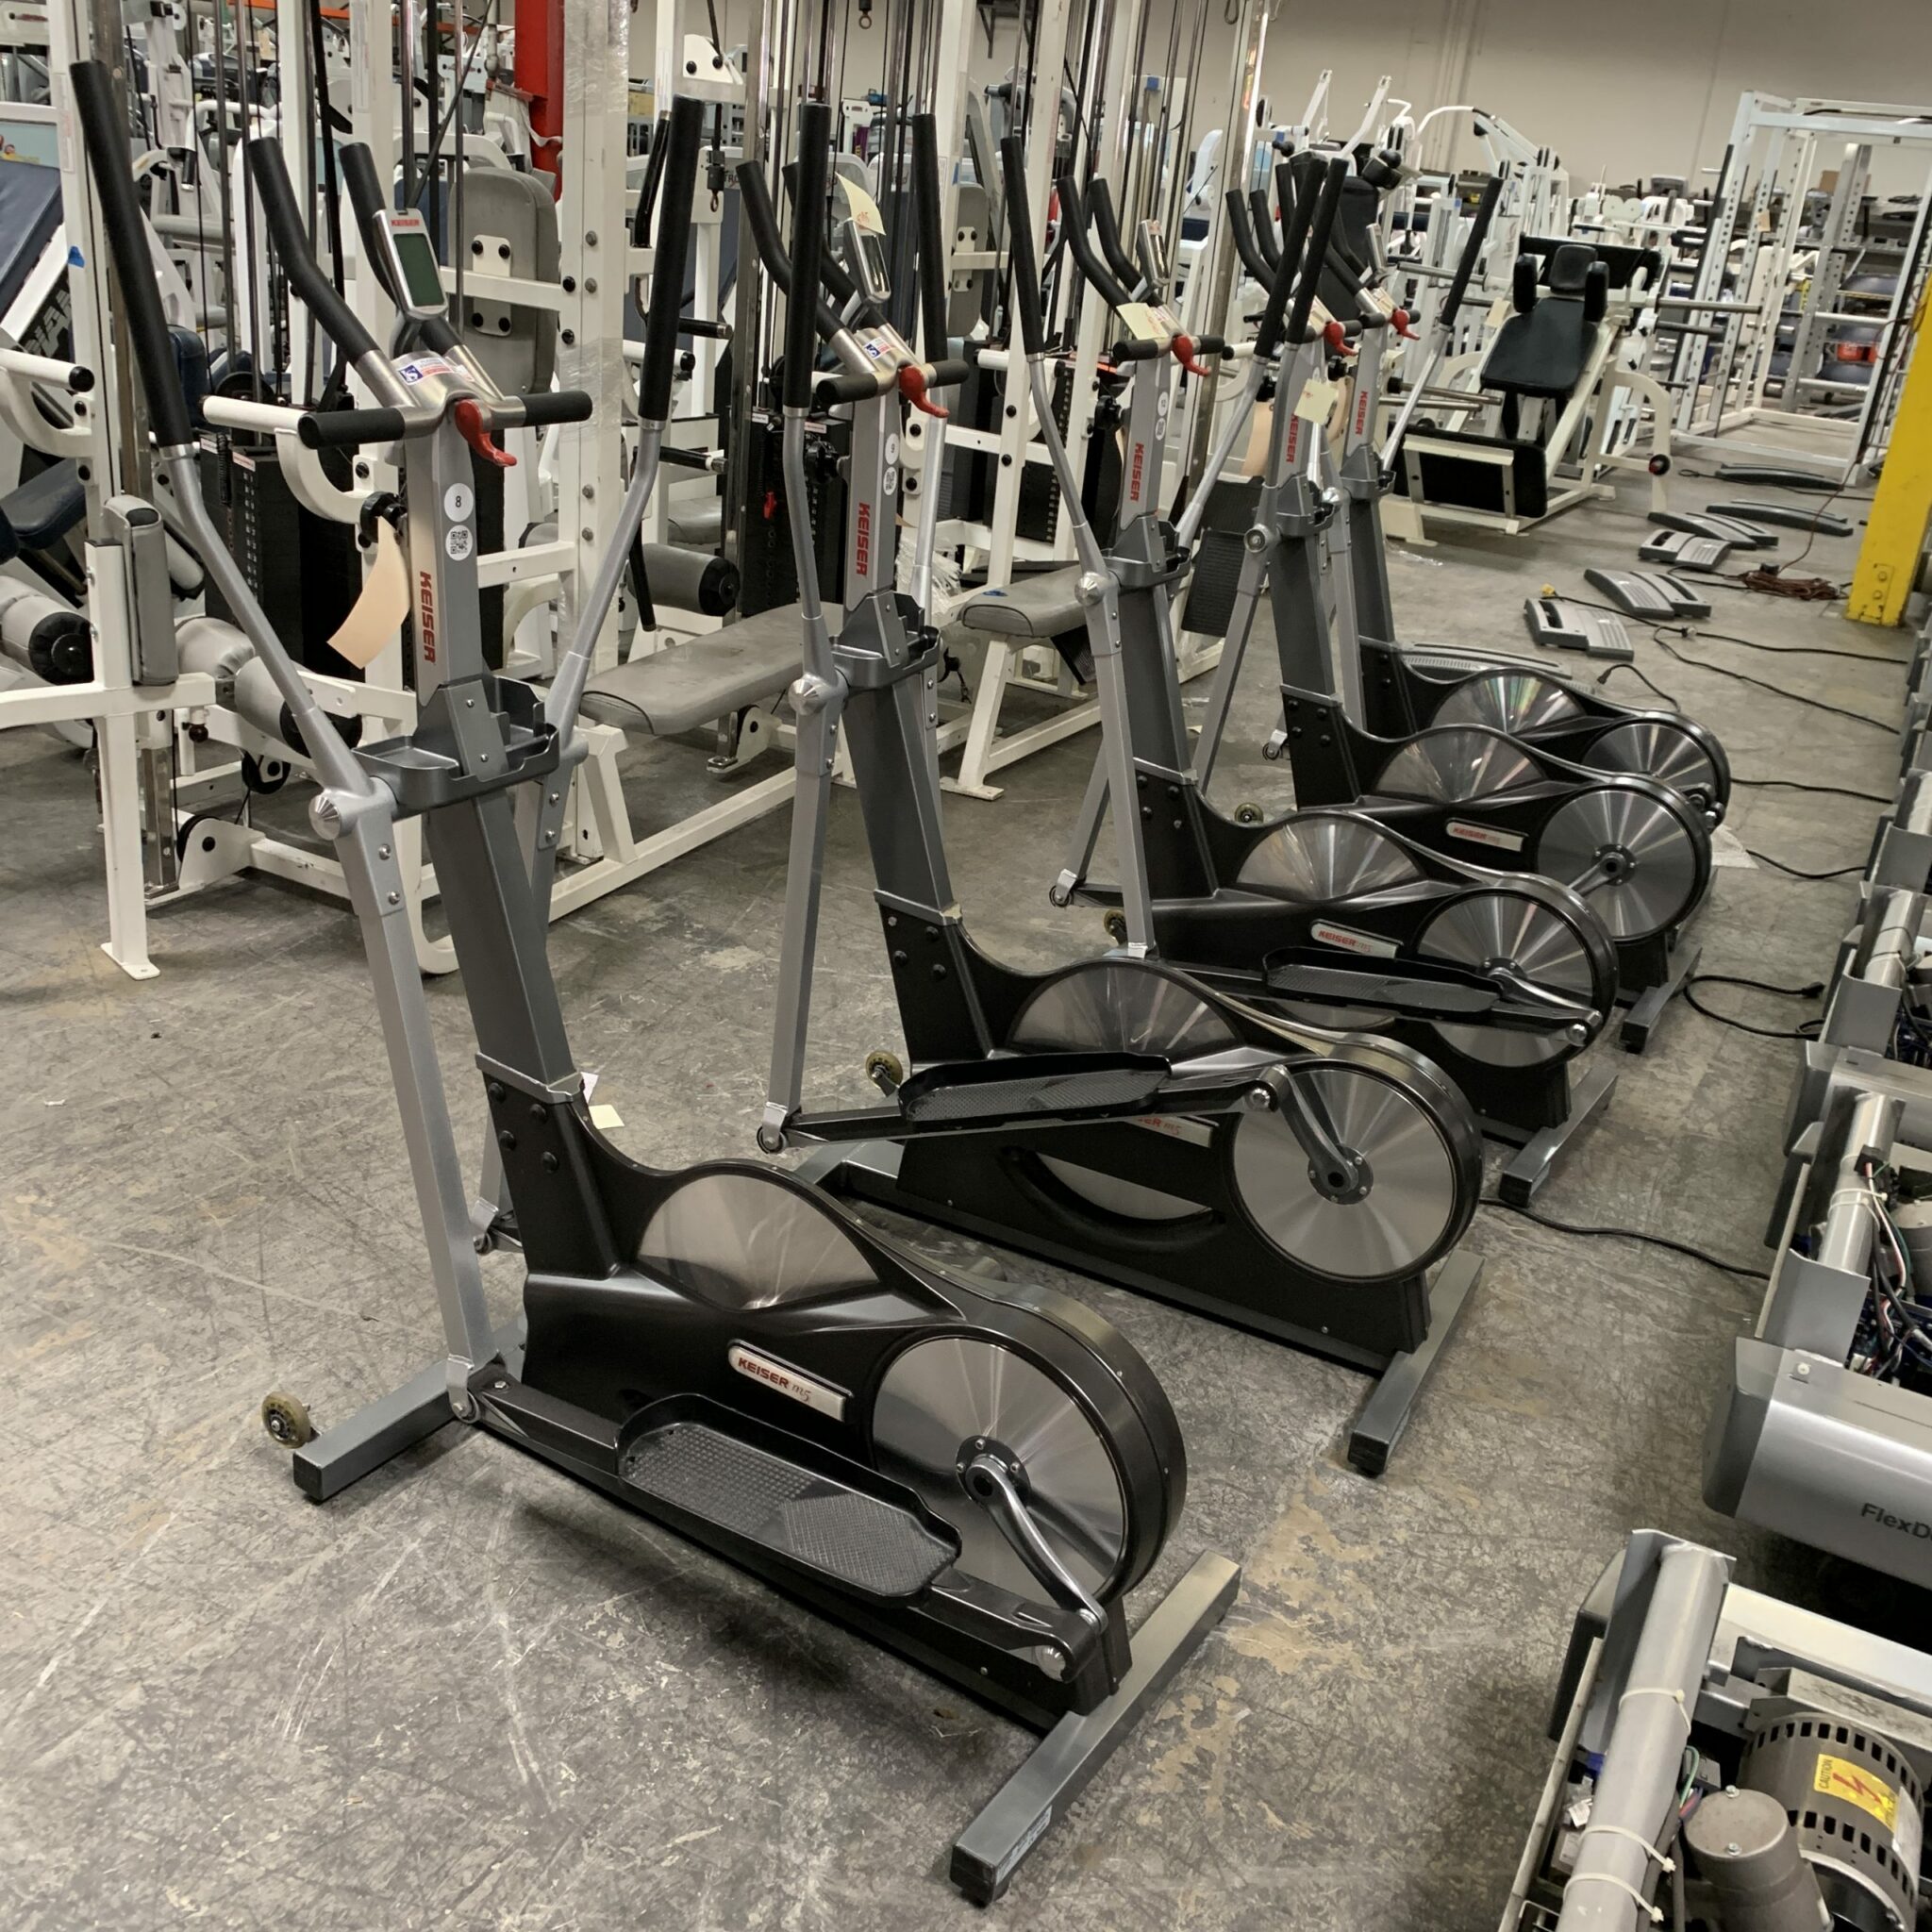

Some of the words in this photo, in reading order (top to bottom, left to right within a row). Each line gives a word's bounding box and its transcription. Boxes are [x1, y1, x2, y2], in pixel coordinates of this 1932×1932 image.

[1356, 391, 1368, 435] KEISER
[1286, 413, 1300, 463] KEISER
[1130, 441, 1144, 501] KEISER
[456, 495, 461, 508] 8
[856, 501, 870, 575] KEISER
[420, 570, 437, 663] KEISER
[1454, 825, 1487, 841] KEISER
[1319, 929, 1357, 947] KEISER
[738, 1357, 790, 1389] KEISER
[1861, 1502, 1932, 1541] FlexD
[1818, 1758, 1833, 1789] CAUTION
